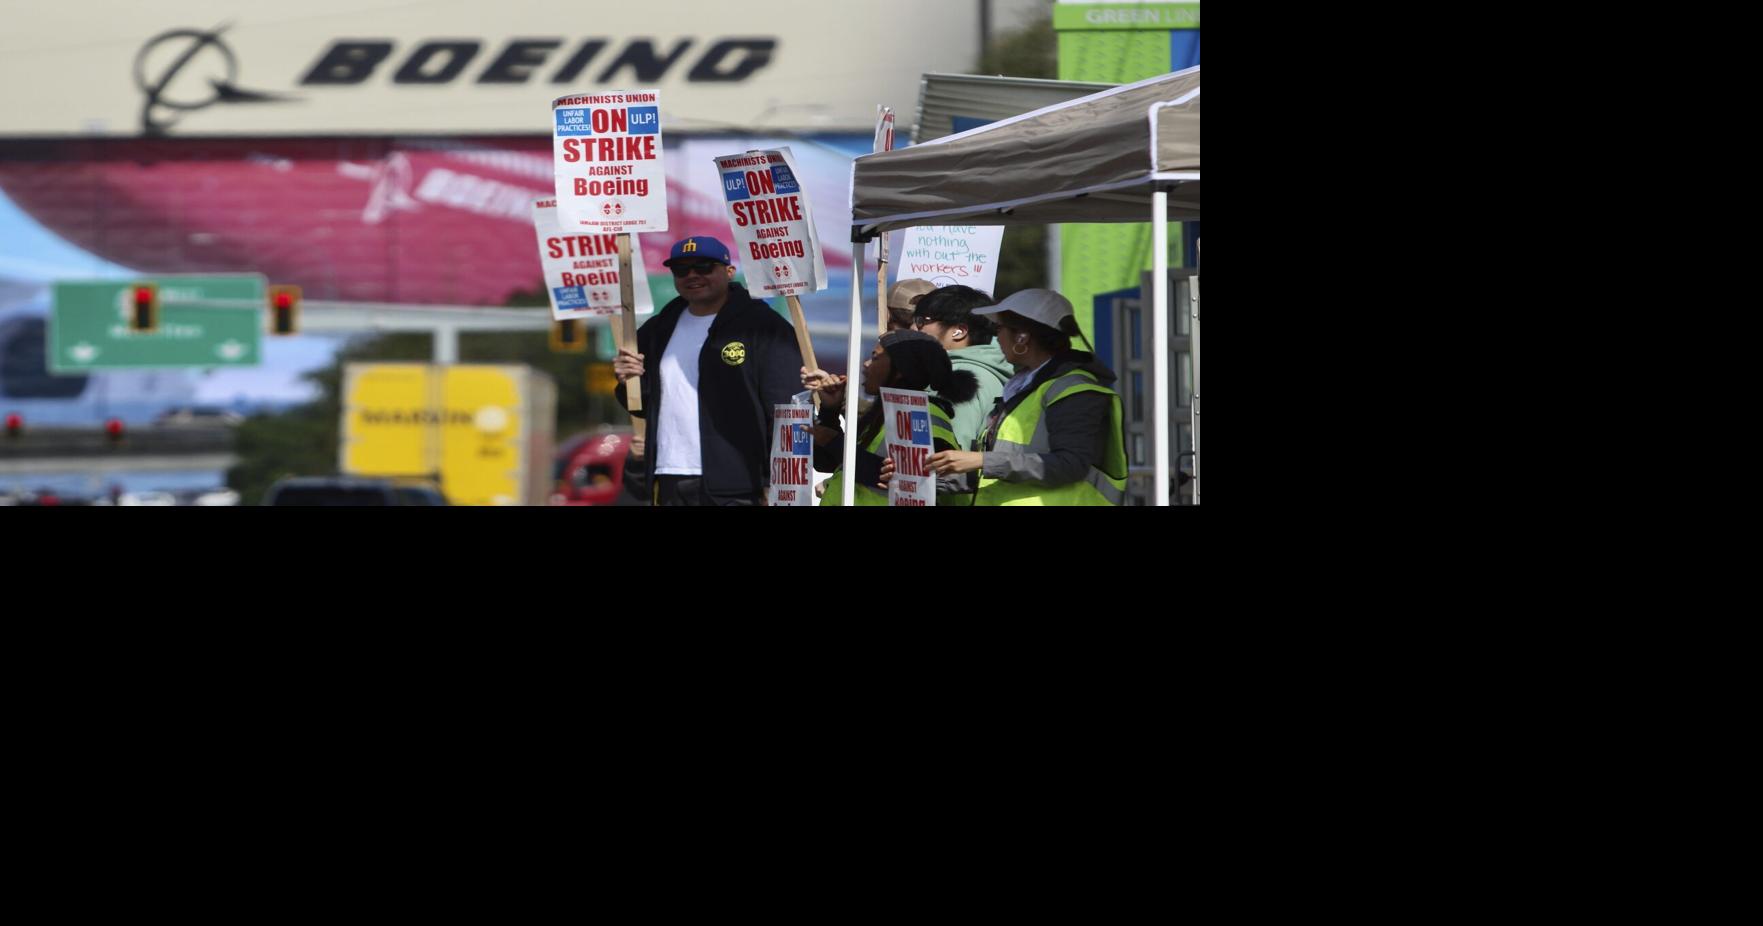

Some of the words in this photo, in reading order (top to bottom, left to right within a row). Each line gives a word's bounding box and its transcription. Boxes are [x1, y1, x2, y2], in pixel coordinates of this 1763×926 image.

[1086, 9, 1160, 24] GREEN
[301, 38, 777, 83] BOEING
[558, 94, 624, 106] MACHINISTS
[625, 93, 656, 103] UNION
[558, 124, 591, 132] PRACTICES!
[592, 109, 626, 133] ON
[630, 113, 656, 124] ULP!
[563, 136, 656, 162] STRIKE
[588, 165, 633, 176] AGAINST
[720, 156, 767, 169] MACHINISTS
[574, 177, 648, 196] Boeing
[726, 178, 746, 191] ULP!
[745, 169, 776, 196] ON
[732, 196, 802, 227] STRIKE
[756, 227, 789, 239] AGAINST
[546, 232, 619, 259] STRIK
[749, 239, 805, 260] Boeing
[918, 236, 970, 252] nothing
[573, 259, 614, 270] AGAINST
[910, 262, 969, 277] workers
[561, 269, 620, 288] Boein
[896, 410, 912, 440] ON
[912, 419, 928, 432] ULP!
[781, 424, 793, 452] ON
[889, 443, 930, 477] STRIKE
[772, 457, 809, 485] STRIKE
